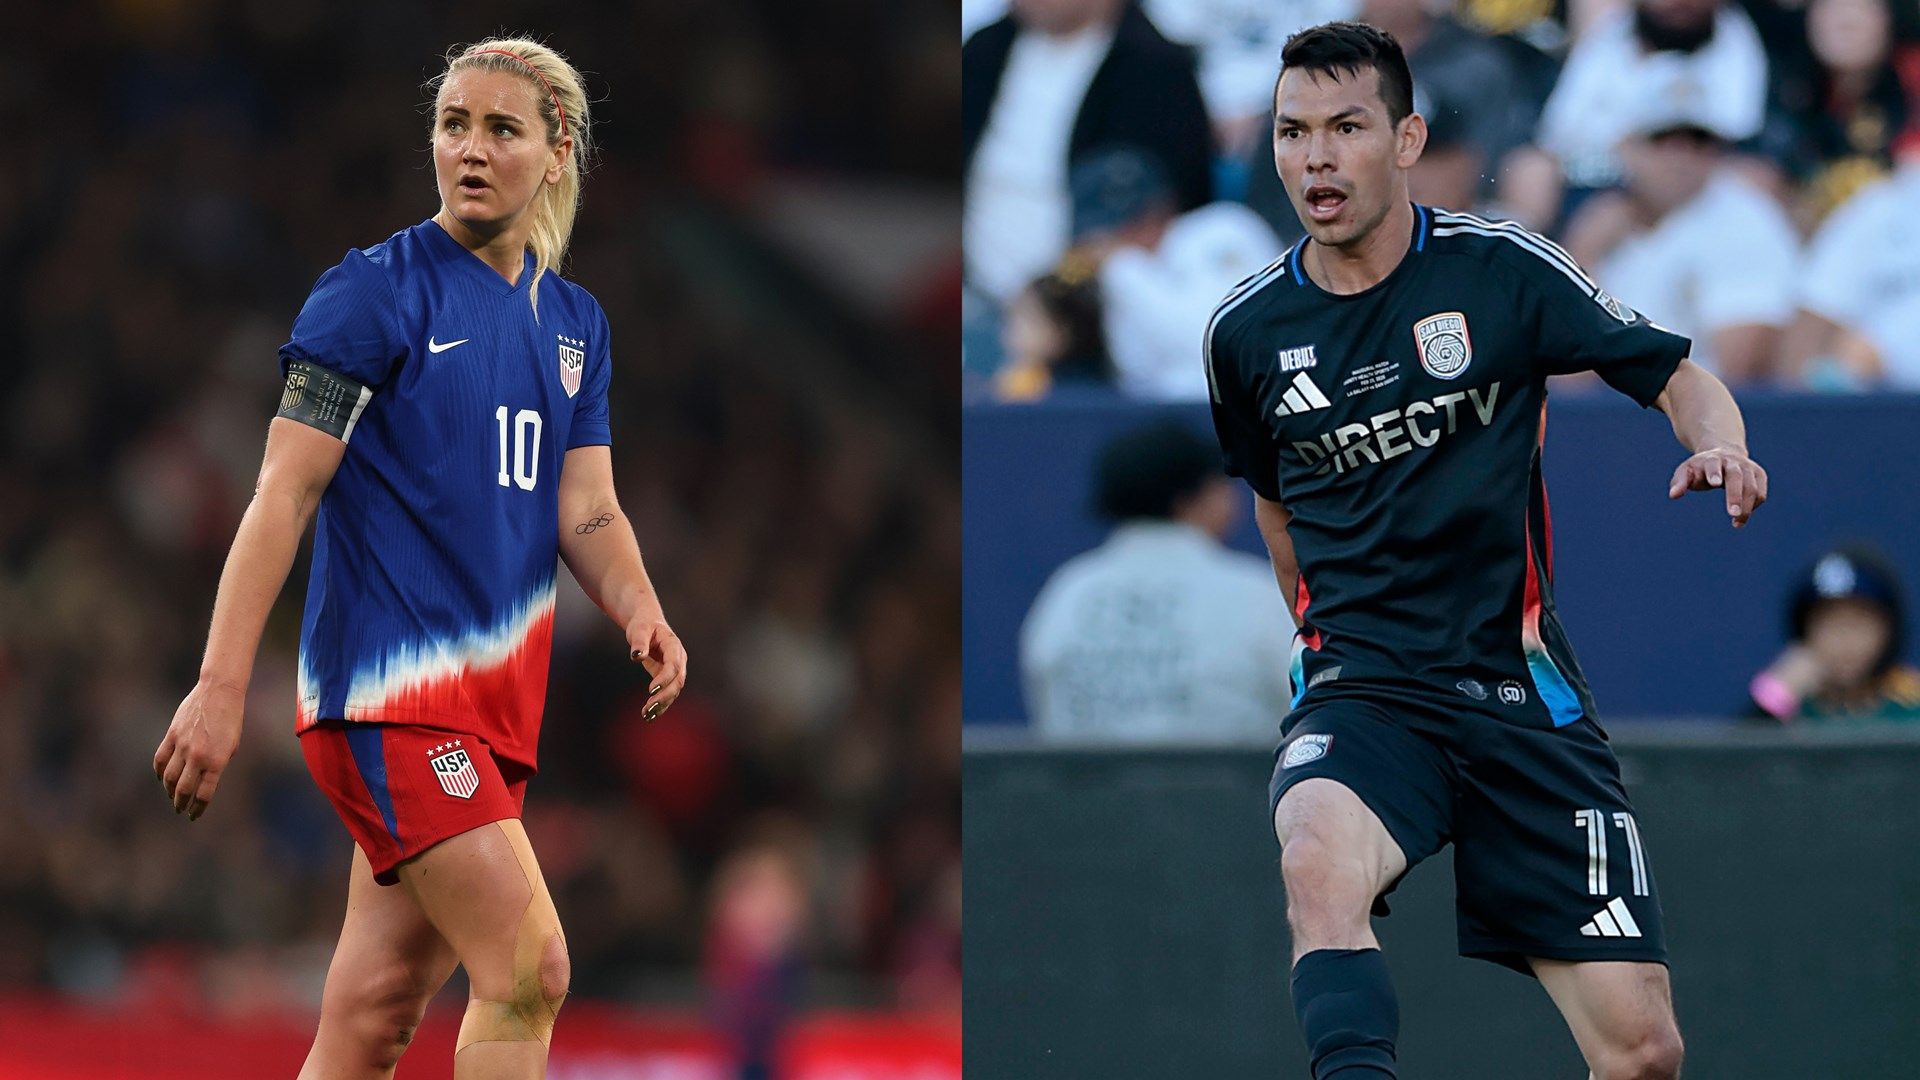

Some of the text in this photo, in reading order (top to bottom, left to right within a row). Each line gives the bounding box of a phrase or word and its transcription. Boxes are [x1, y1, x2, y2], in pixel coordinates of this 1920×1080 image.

[1420, 319, 1461, 338] SAN DIEGO
[561, 347, 582, 369] USA
[1280, 346, 1317, 371] DEBUT
[1292, 382, 1500, 475] DIRECTV
[496, 405, 543, 492] 10
[1503, 686, 1520, 701] SD
[434, 751, 468, 772] USA
[1575, 809, 1649, 896] 11
